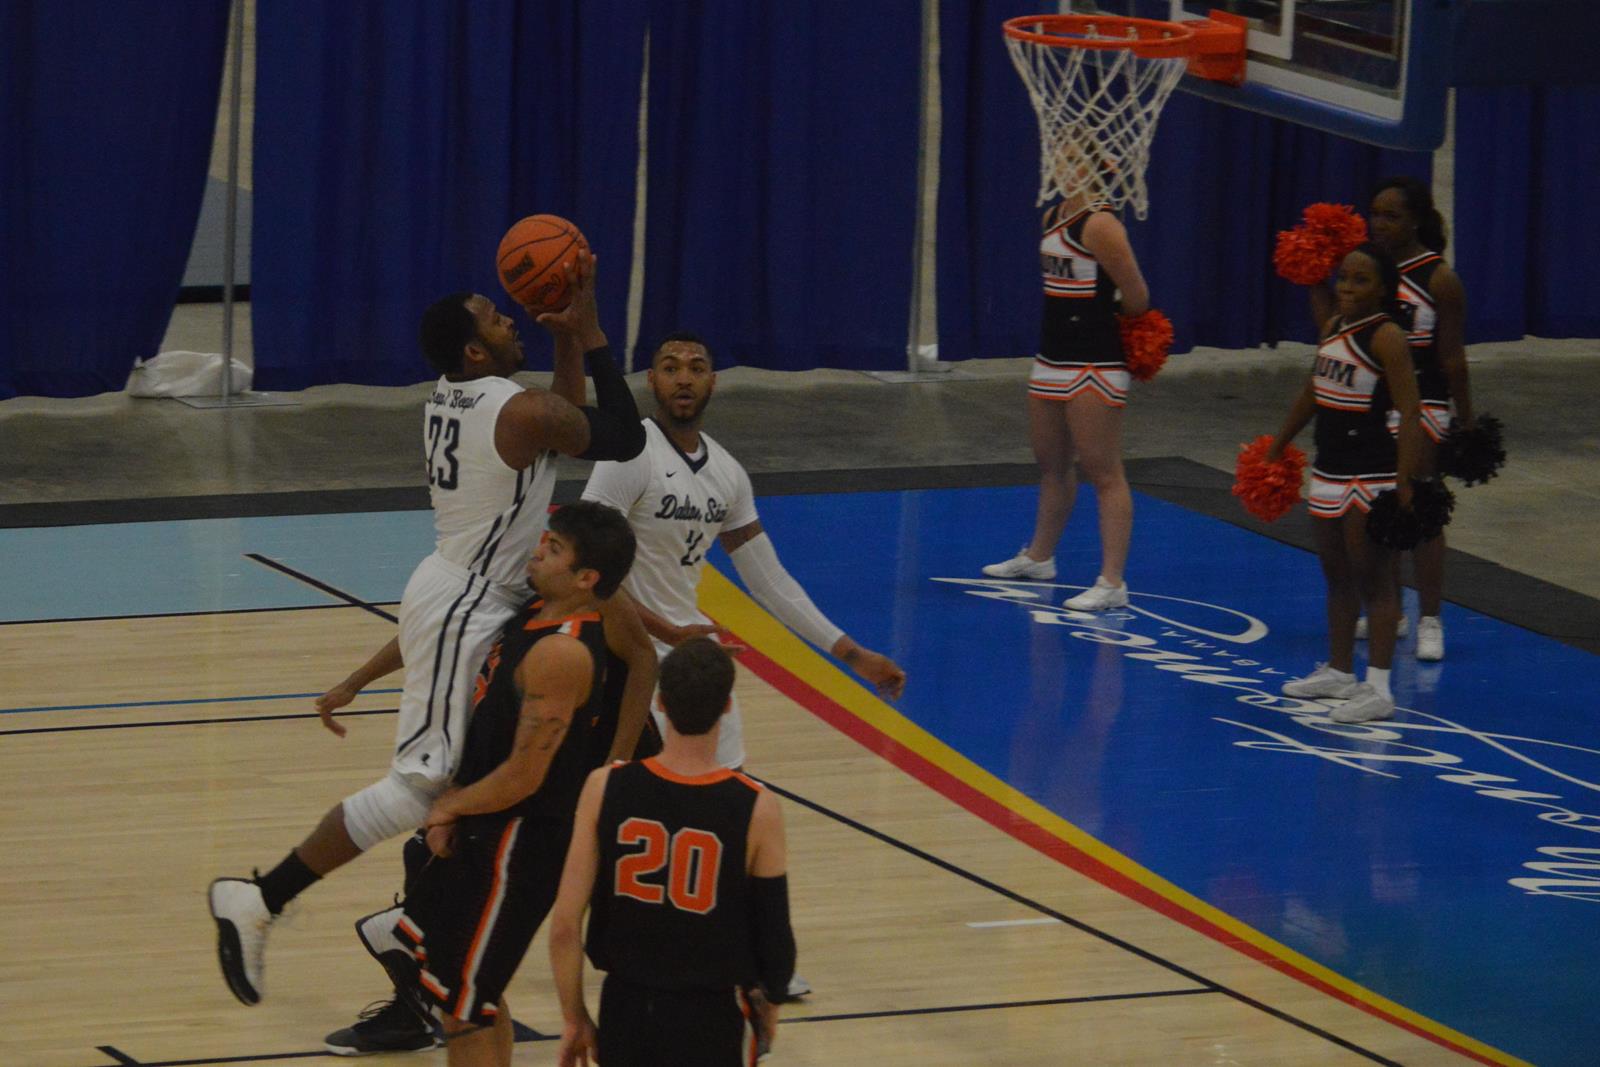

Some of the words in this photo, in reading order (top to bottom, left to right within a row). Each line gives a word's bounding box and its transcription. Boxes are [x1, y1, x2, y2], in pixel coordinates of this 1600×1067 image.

[1041, 255, 1075, 279] UM
[1315, 355, 1357, 387] UM
[655, 494, 702, 520] Dalton
[614, 816, 724, 915] 20
